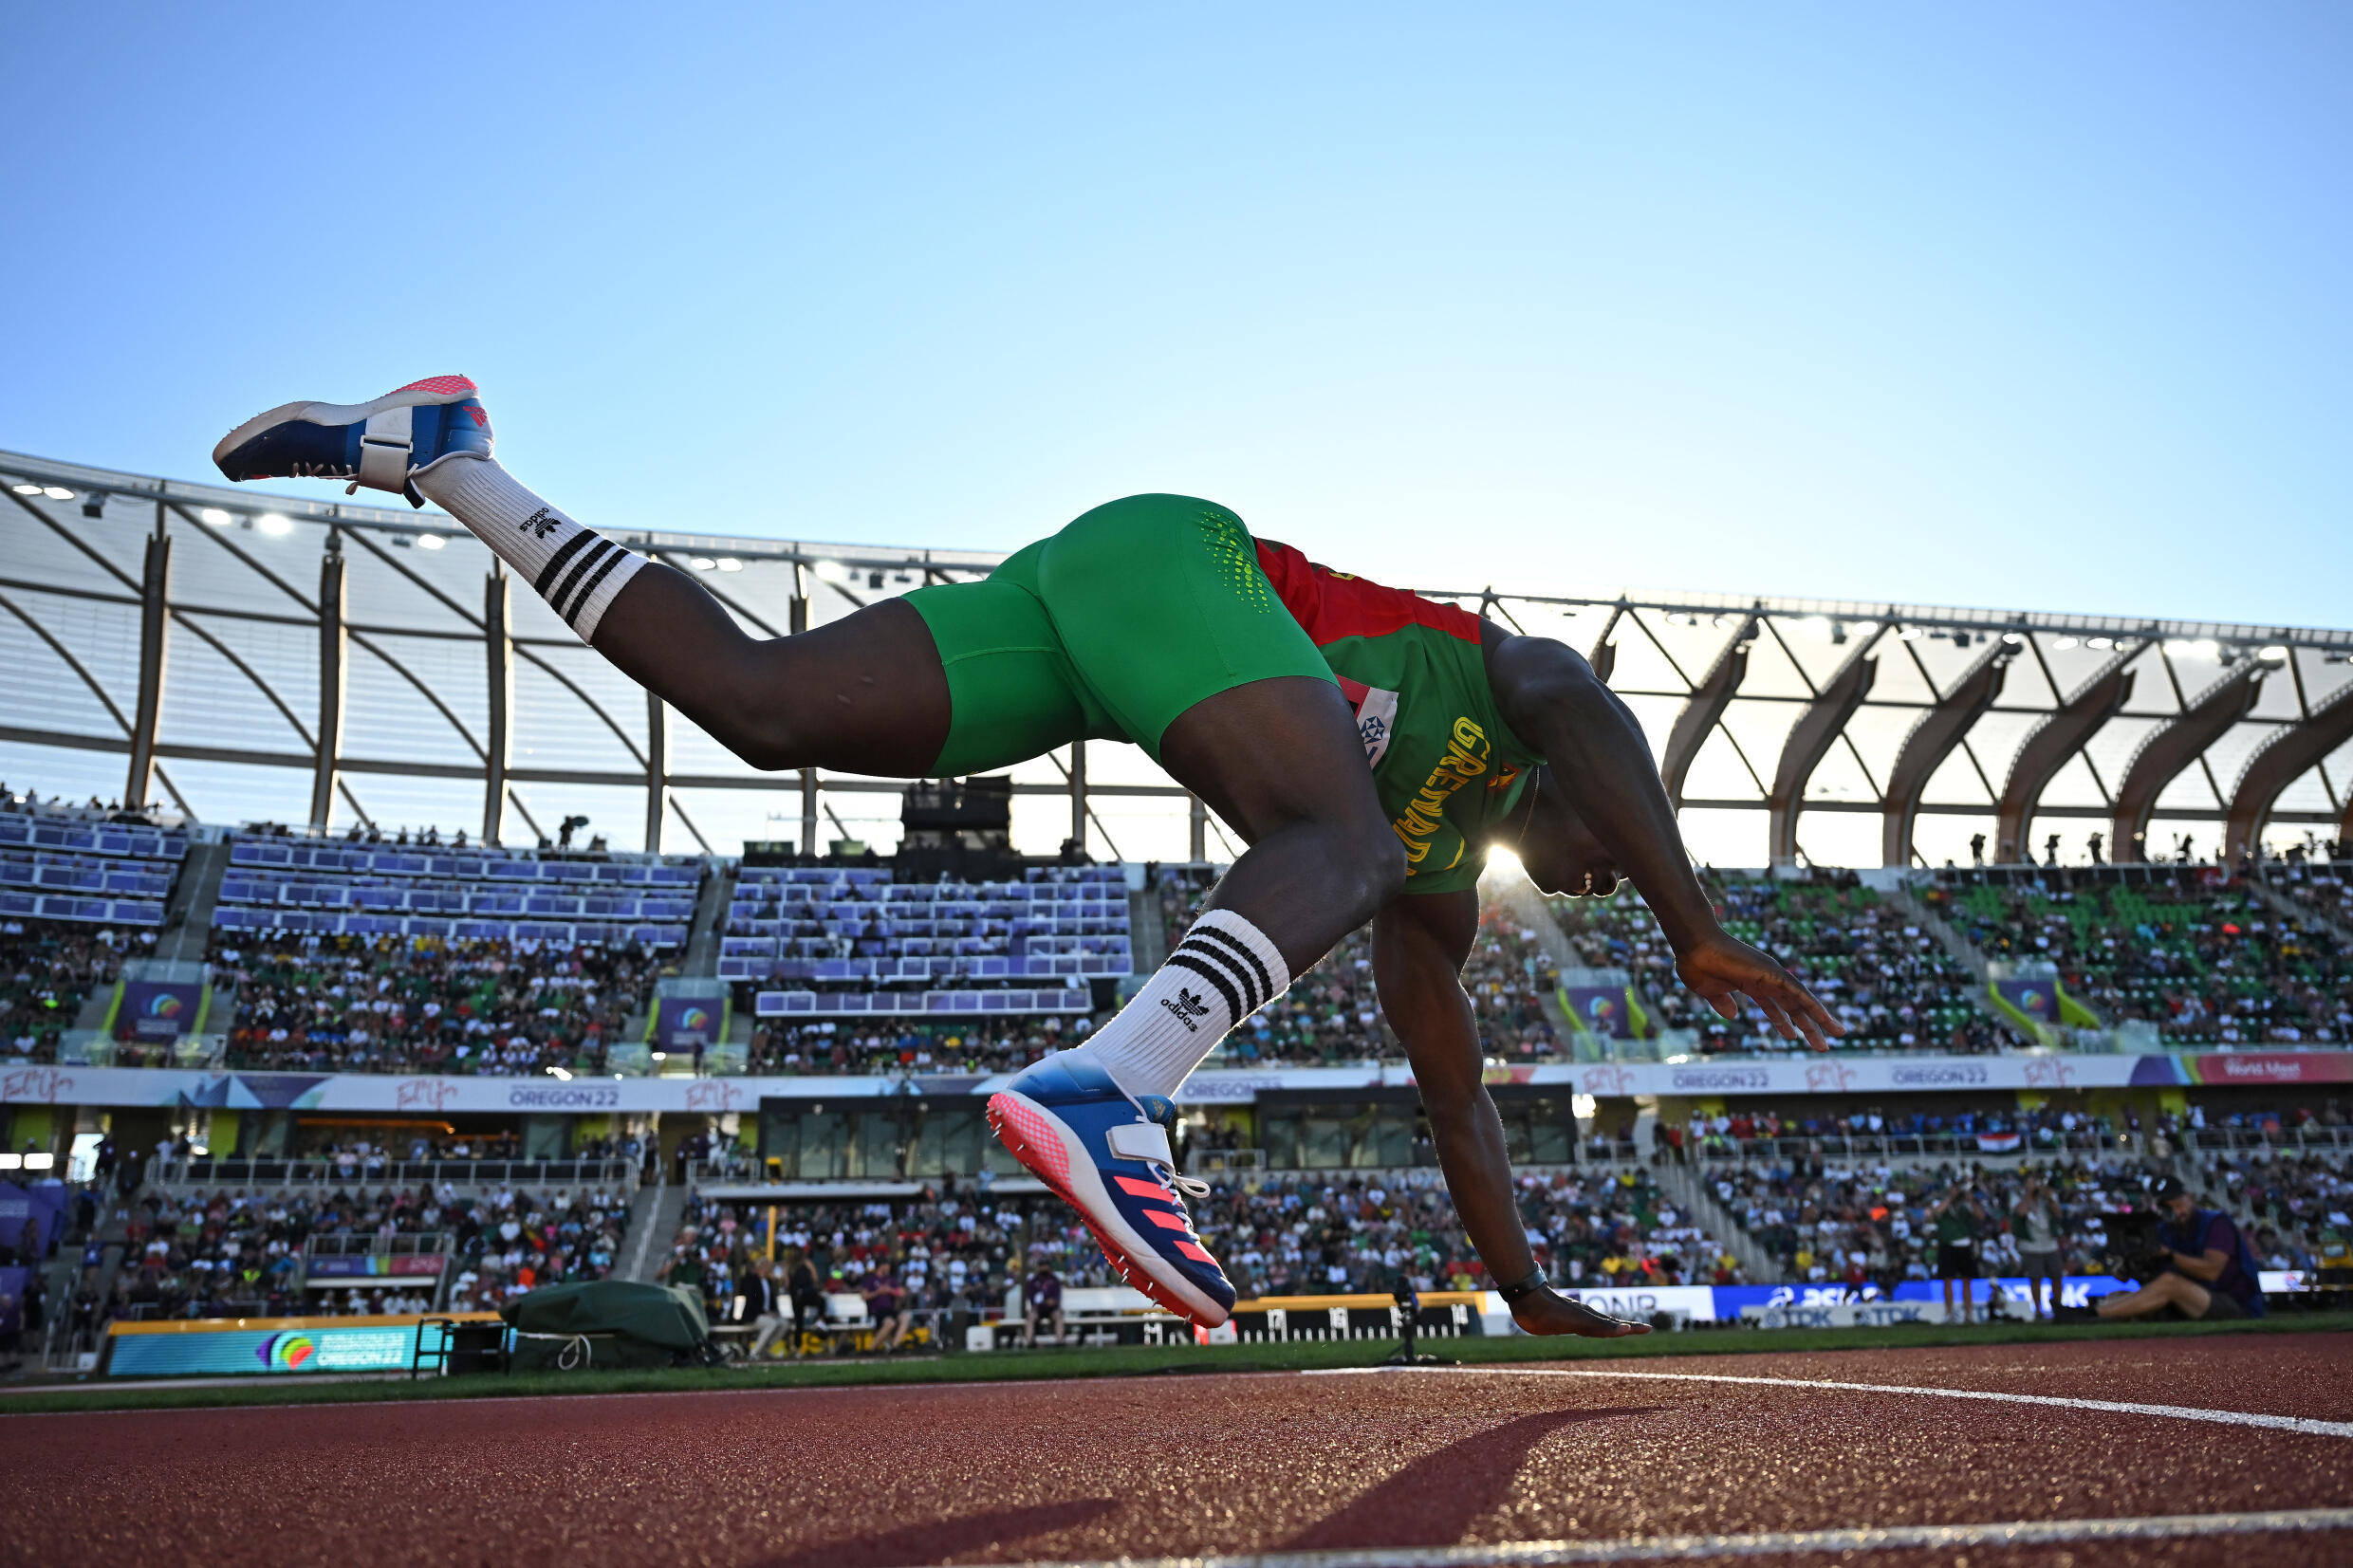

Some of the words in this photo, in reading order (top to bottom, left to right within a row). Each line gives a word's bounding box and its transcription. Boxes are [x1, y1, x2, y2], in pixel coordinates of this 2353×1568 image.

[519, 507, 549, 532] adidas
[1393, 716, 1487, 876] GRENAD
[1160, 999, 1197, 1032] adidas
[1784, 1309, 1833, 1326] TDK
